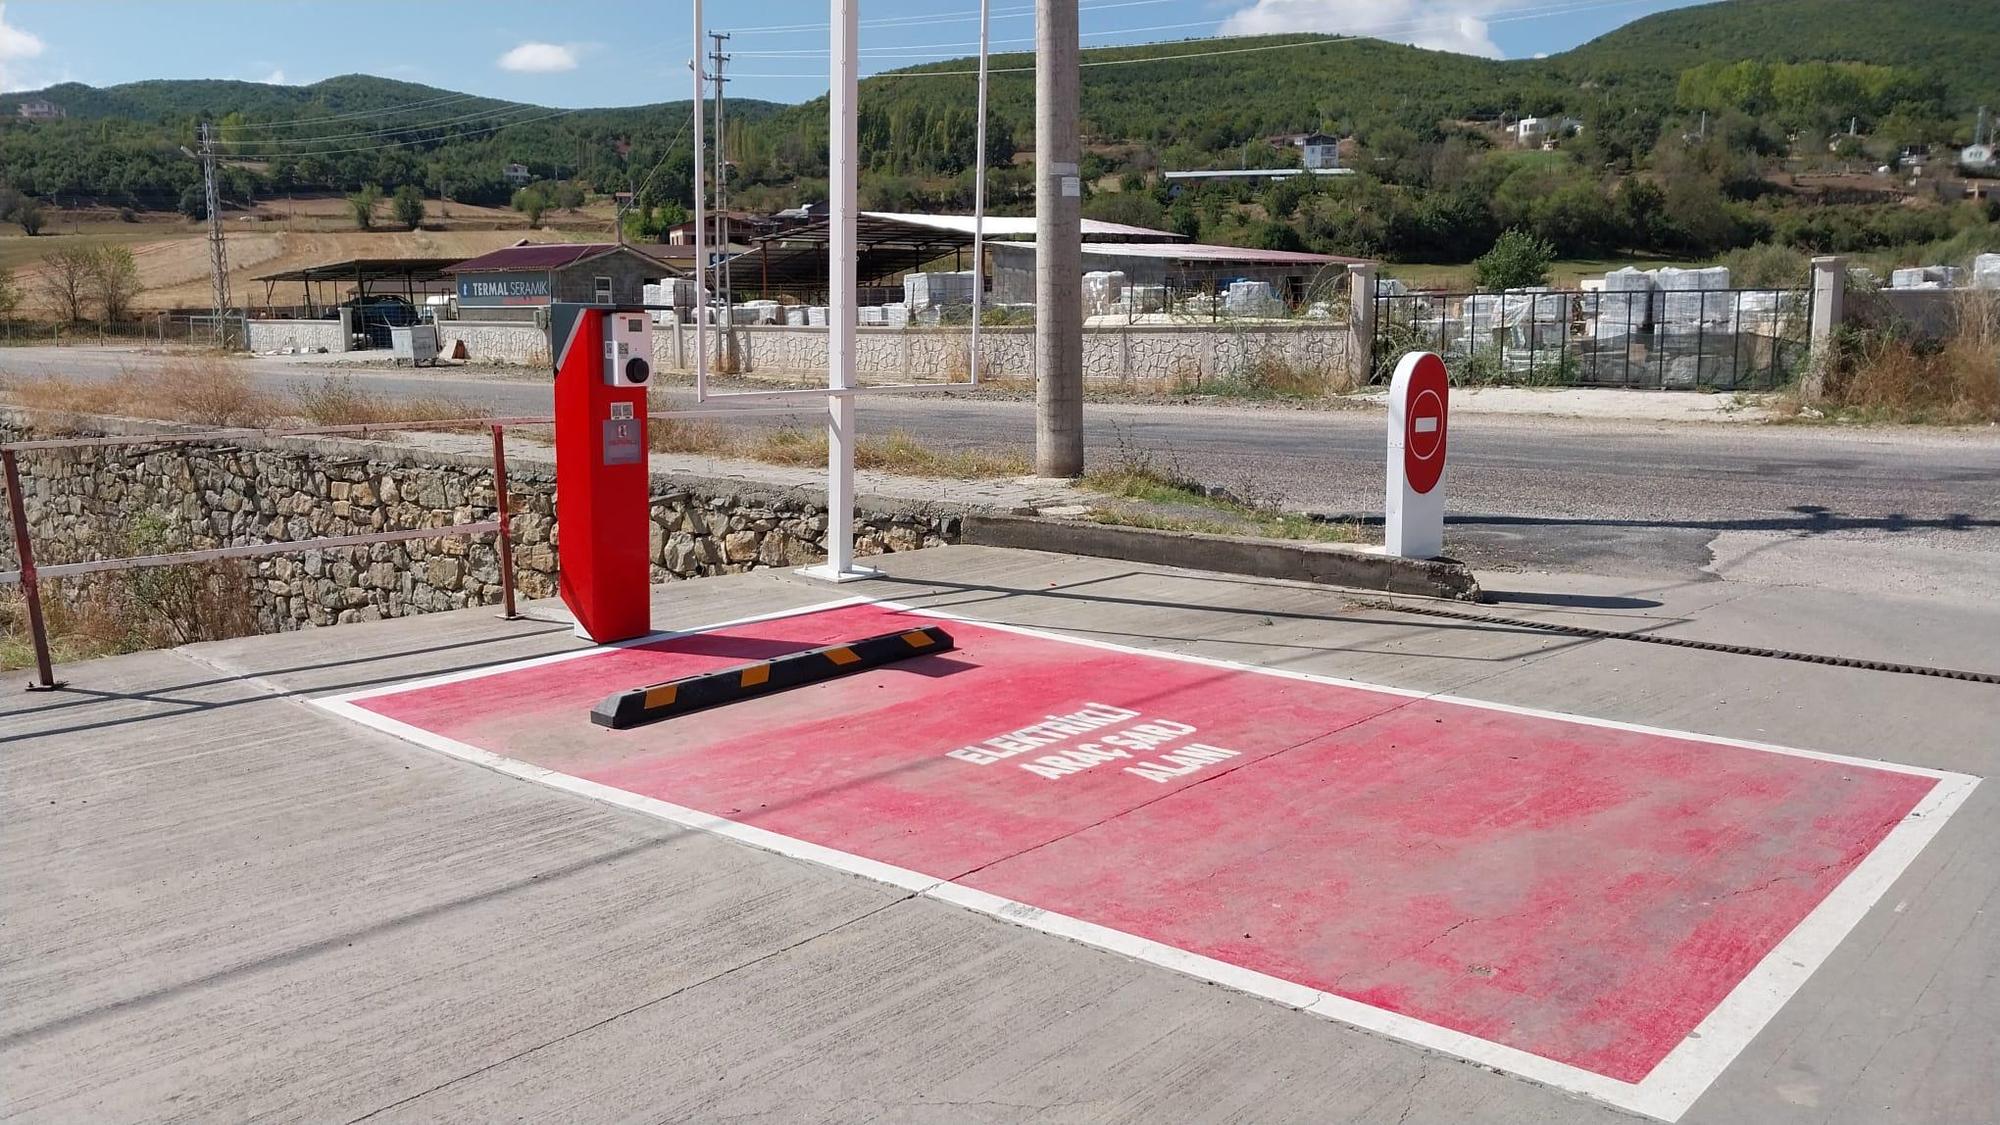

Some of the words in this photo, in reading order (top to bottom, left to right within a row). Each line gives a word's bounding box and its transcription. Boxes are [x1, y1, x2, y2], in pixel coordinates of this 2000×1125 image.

[472, 282, 509, 297] TERMAL
[1019, 743, 1133, 780] ARAÇ
[1123, 743, 1242, 783] ALANI
